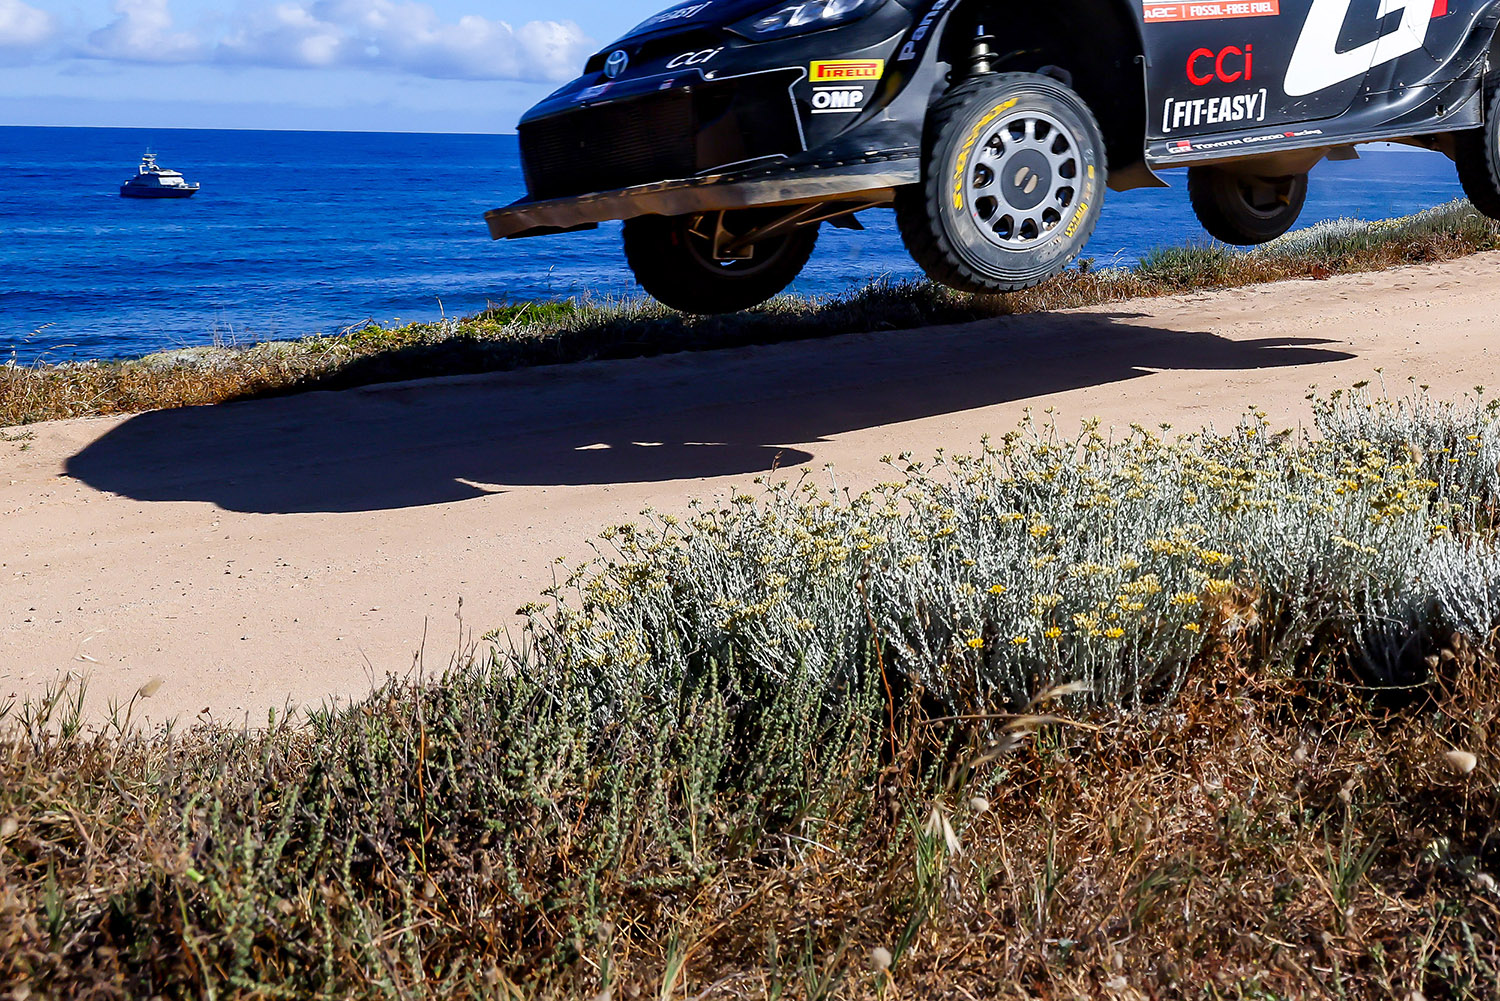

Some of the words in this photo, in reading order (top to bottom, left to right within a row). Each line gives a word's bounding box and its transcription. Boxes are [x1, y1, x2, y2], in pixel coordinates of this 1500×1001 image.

[1190, 3, 1250, 17] FOSSIL-FREE
[1250, 2, 1274, 13] FUEL
[817, 63, 878, 79] PIRELLI
[811, 90, 864, 109] OMP
